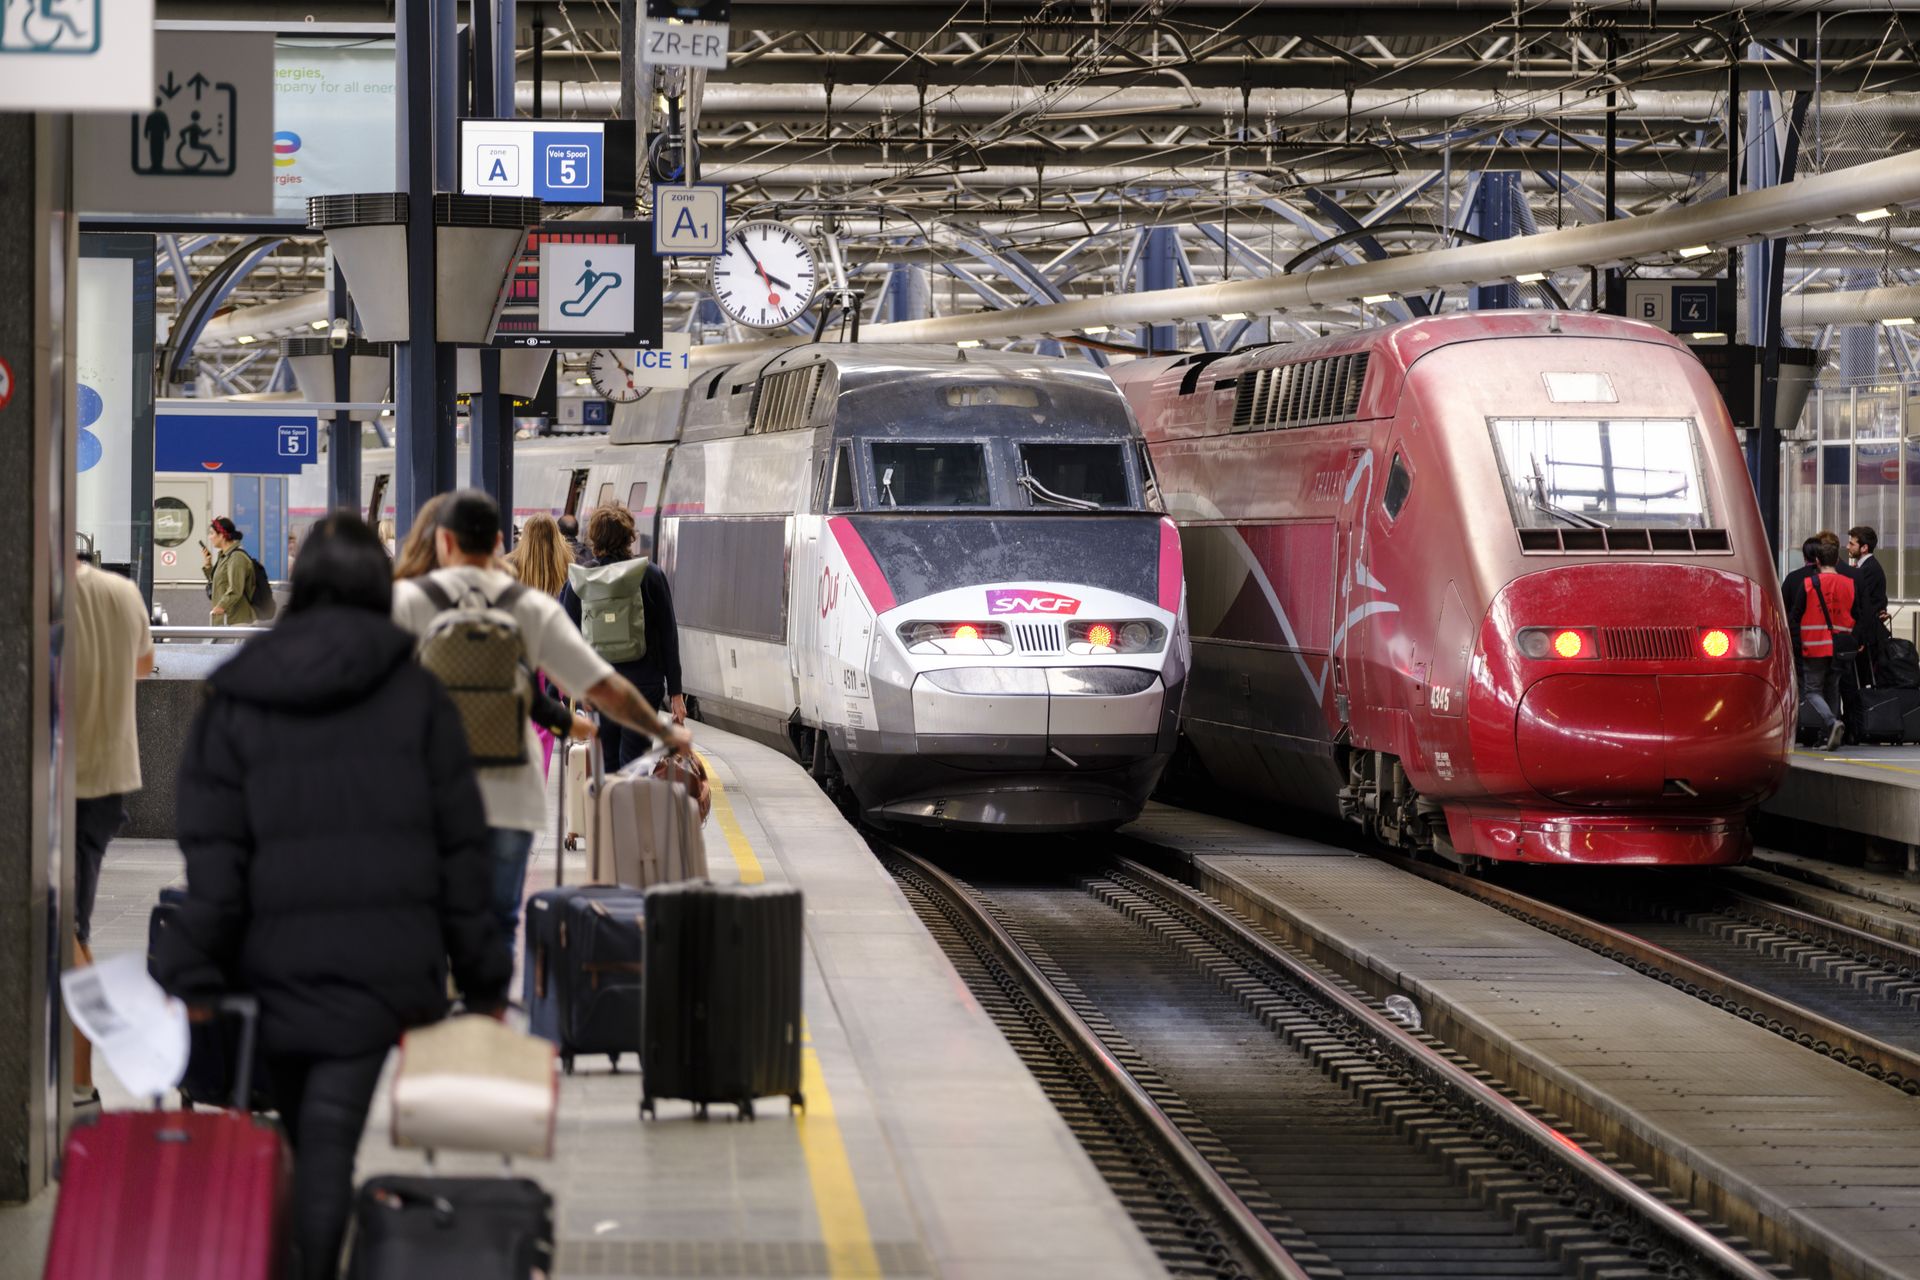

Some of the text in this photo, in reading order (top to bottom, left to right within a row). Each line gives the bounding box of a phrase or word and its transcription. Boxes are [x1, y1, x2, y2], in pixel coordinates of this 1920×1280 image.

[651, 31, 720, 57] ZR-ER
[321, 80, 340, 93] for
[344, 81, 359, 93] all
[549, 150, 587, 159] Voie Spoor
[488, 158, 508, 181] A
[560, 160, 576, 184] 5
[671, 193, 695, 202] zone
[1644, 302, 1655, 318] B
[1688, 303, 1700, 319] 4
[636, 351, 689, 369] ICE 1
[288, 436, 299, 453] 5
[992, 598, 1075, 612] SNCF
[1431, 686, 1450, 712] 4345
